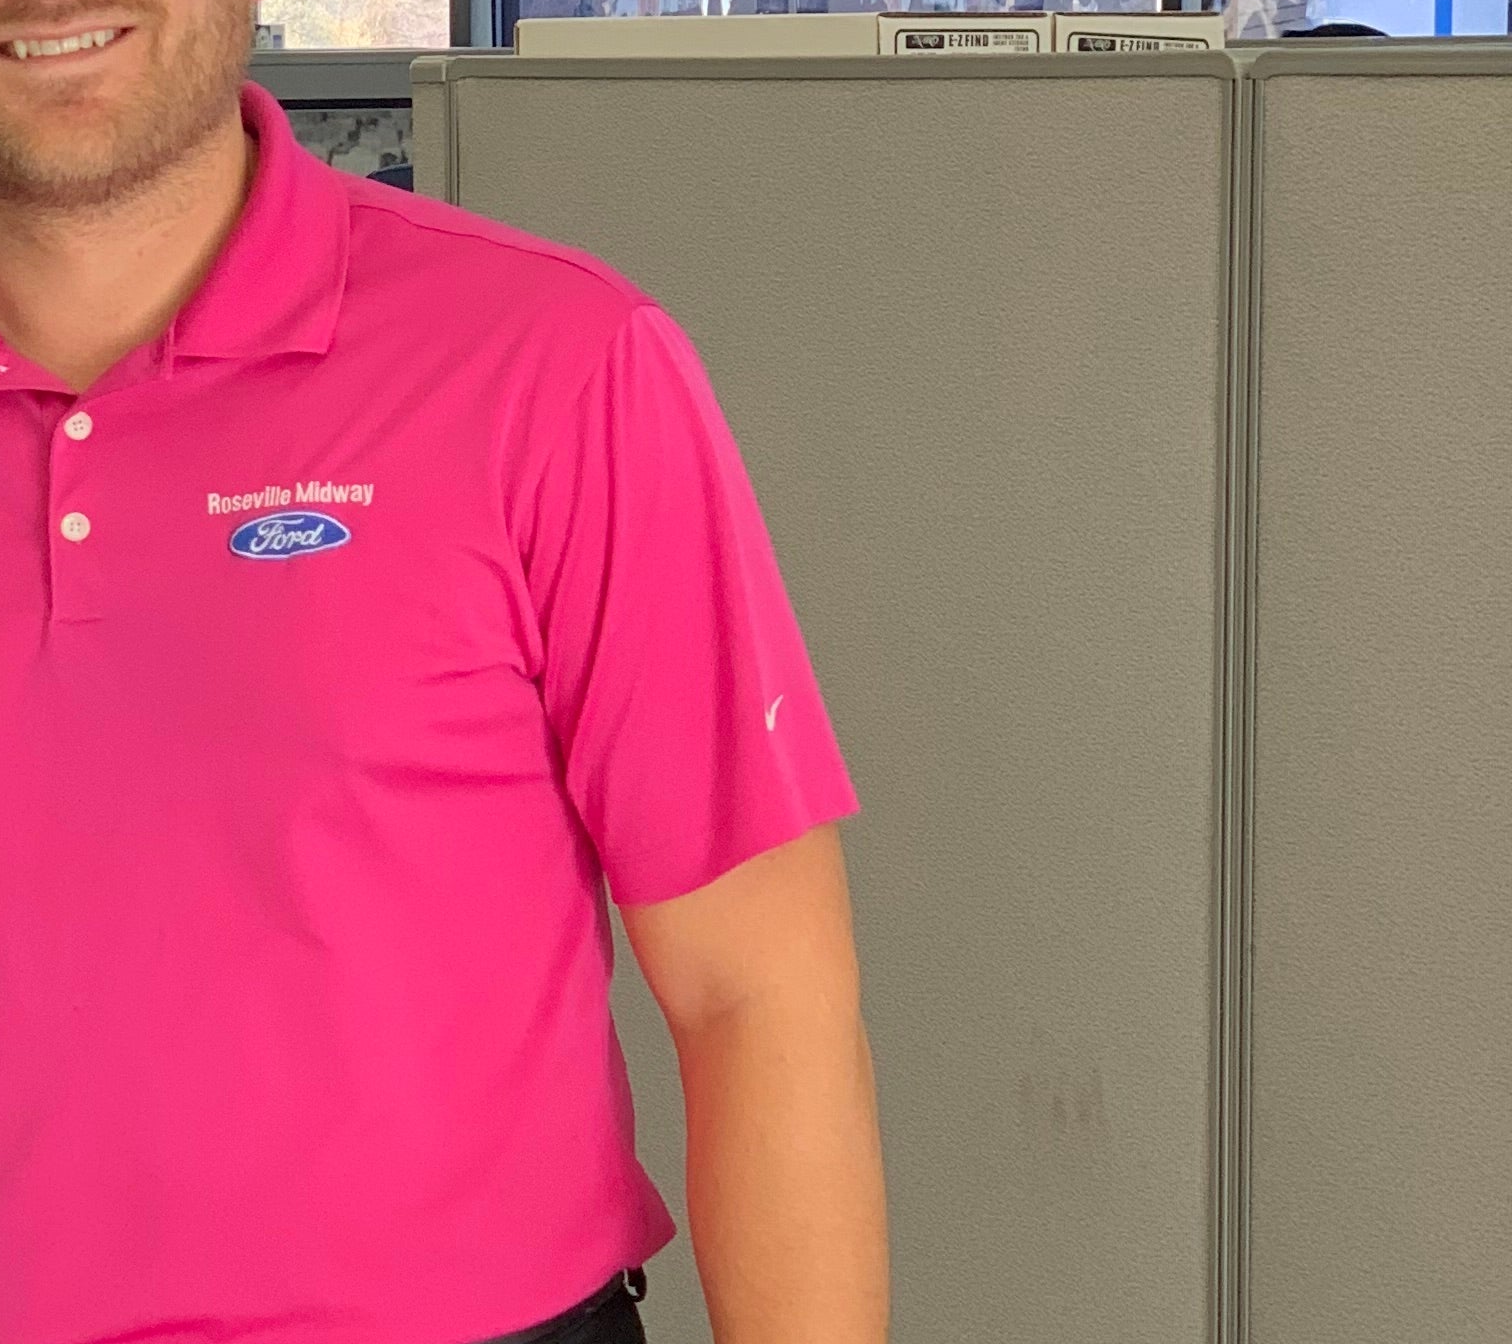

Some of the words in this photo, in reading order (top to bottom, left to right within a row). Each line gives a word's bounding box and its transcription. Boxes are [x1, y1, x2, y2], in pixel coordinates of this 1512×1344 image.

[207, 485, 291, 515] Roseville
[295, 481, 374, 506] Midway
[250, 518, 324, 552] Ford
